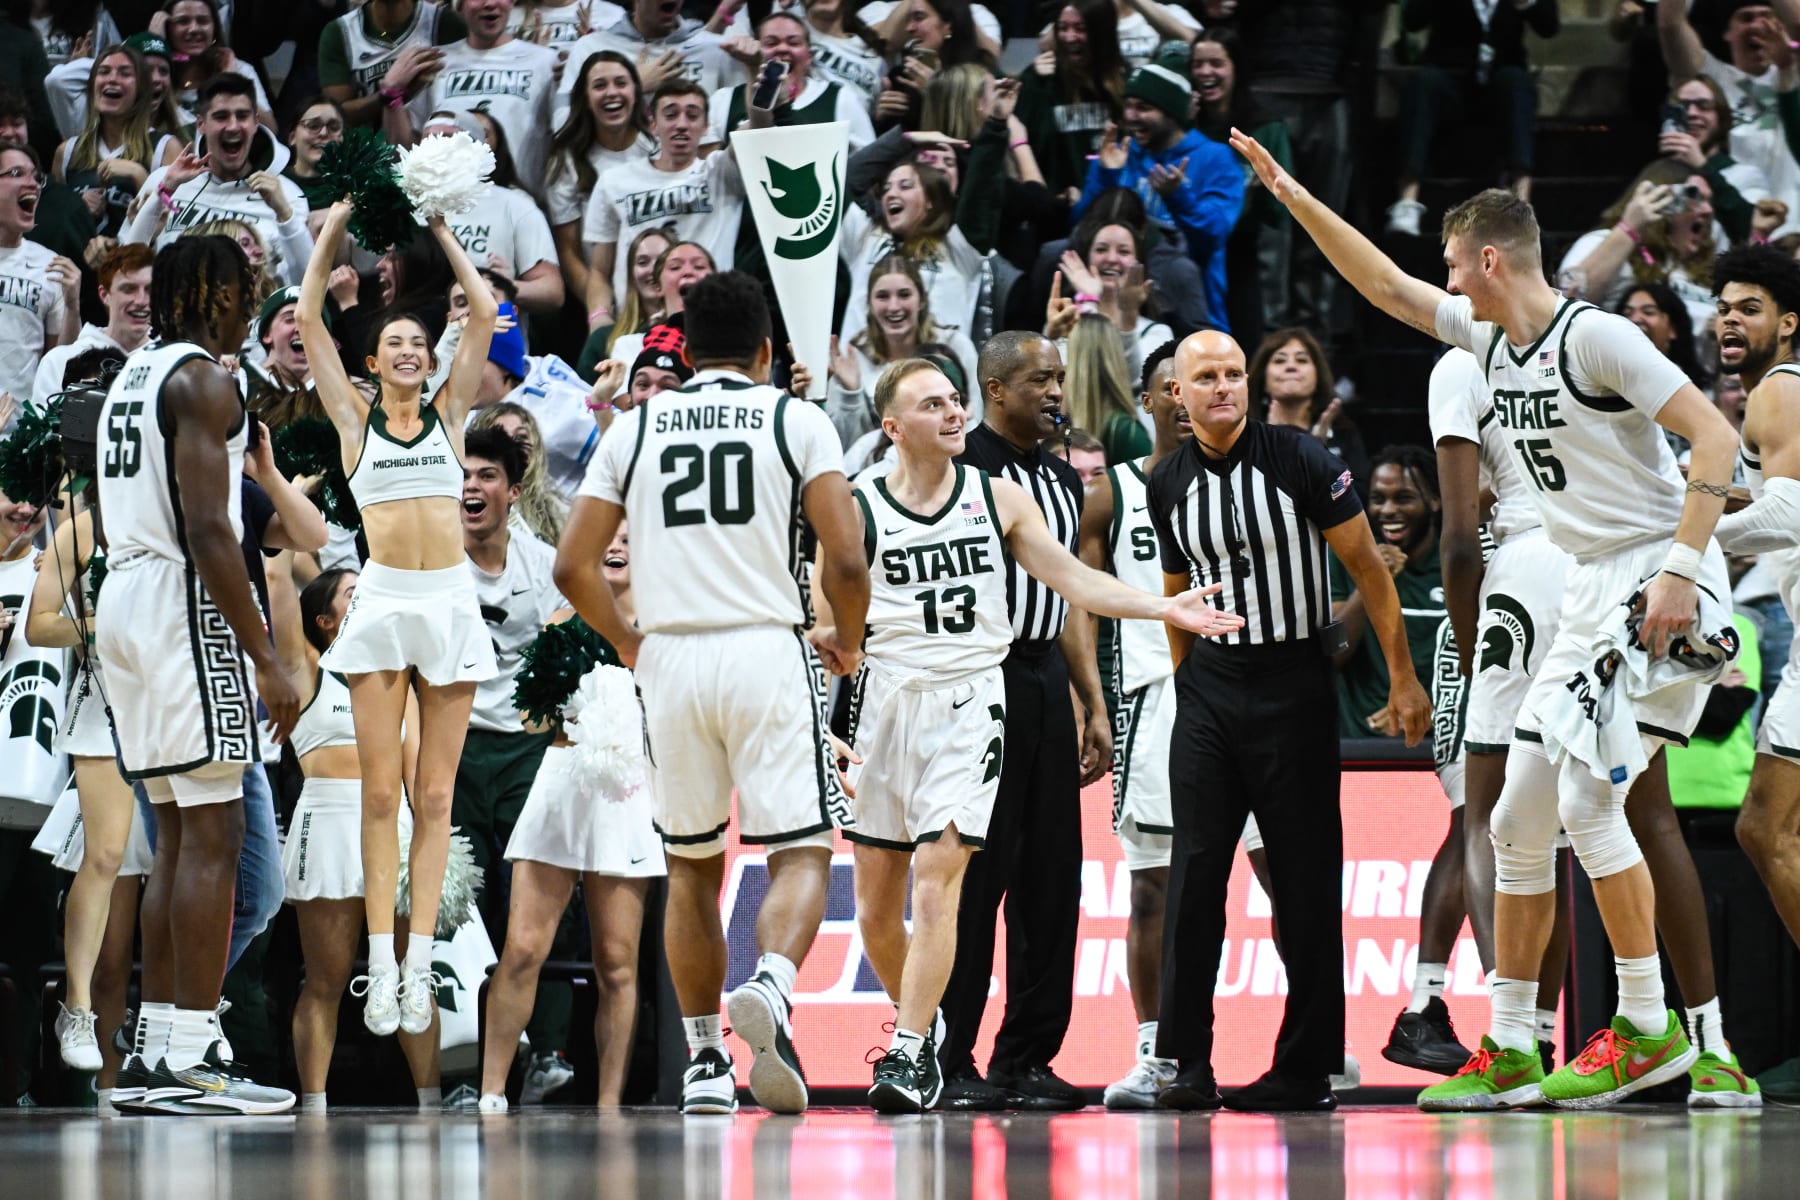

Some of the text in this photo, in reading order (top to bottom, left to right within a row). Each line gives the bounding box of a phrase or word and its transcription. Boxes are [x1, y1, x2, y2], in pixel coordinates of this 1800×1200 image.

[446, 69, 533, 100] IZZONE
[626, 182, 714, 227] IZZONE
[124, 366, 151, 390] CARR
[655, 405, 764, 433] SANDERS
[1493, 388, 1568, 430] STATE
[104, 401, 144, 478] 55
[372, 455, 447, 470] MICHIGAN STATE
[660, 441, 755, 528] 20
[1514, 438, 1567, 491] 15
[881, 535, 995, 586] STATE
[914, 584, 976, 634] 13
[298, 810, 312, 881] MICHIGAN STATE
